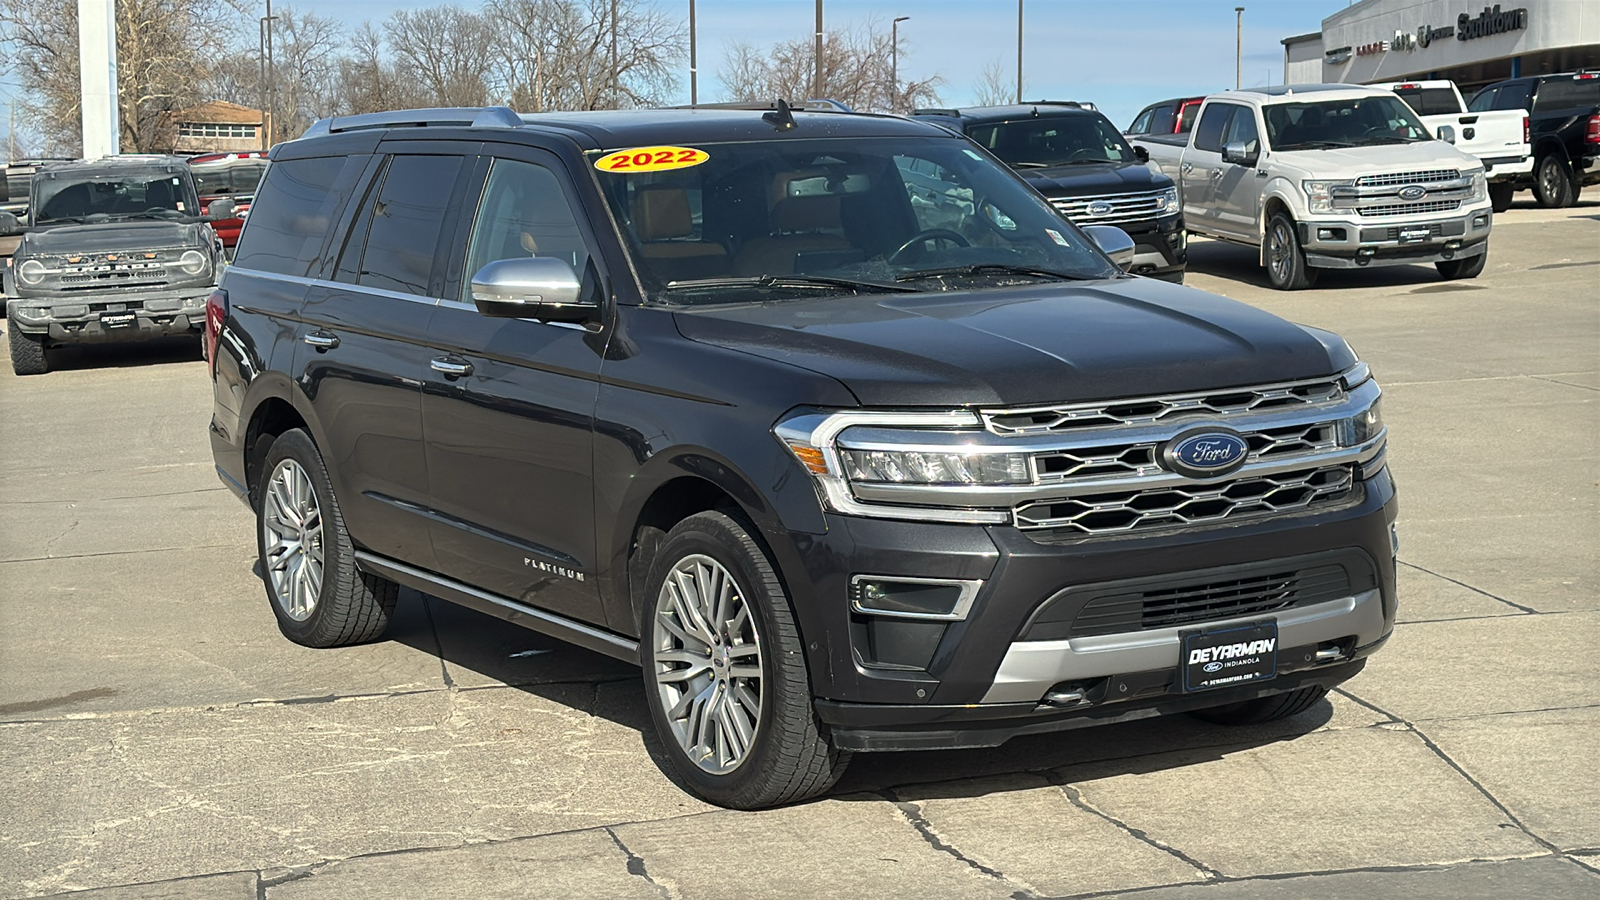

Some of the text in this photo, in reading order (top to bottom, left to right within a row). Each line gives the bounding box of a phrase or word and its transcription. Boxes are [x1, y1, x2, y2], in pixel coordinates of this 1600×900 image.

[1457, 4, 1528, 41] Southtown
[610, 150, 697, 169] 2022
[1192, 440, 1232, 463] Ford
[524, 557, 585, 582] PLATINUM
[1188, 638, 1276, 665] DEYARMAN
[1224, 657, 1260, 668] INDIANOLA
